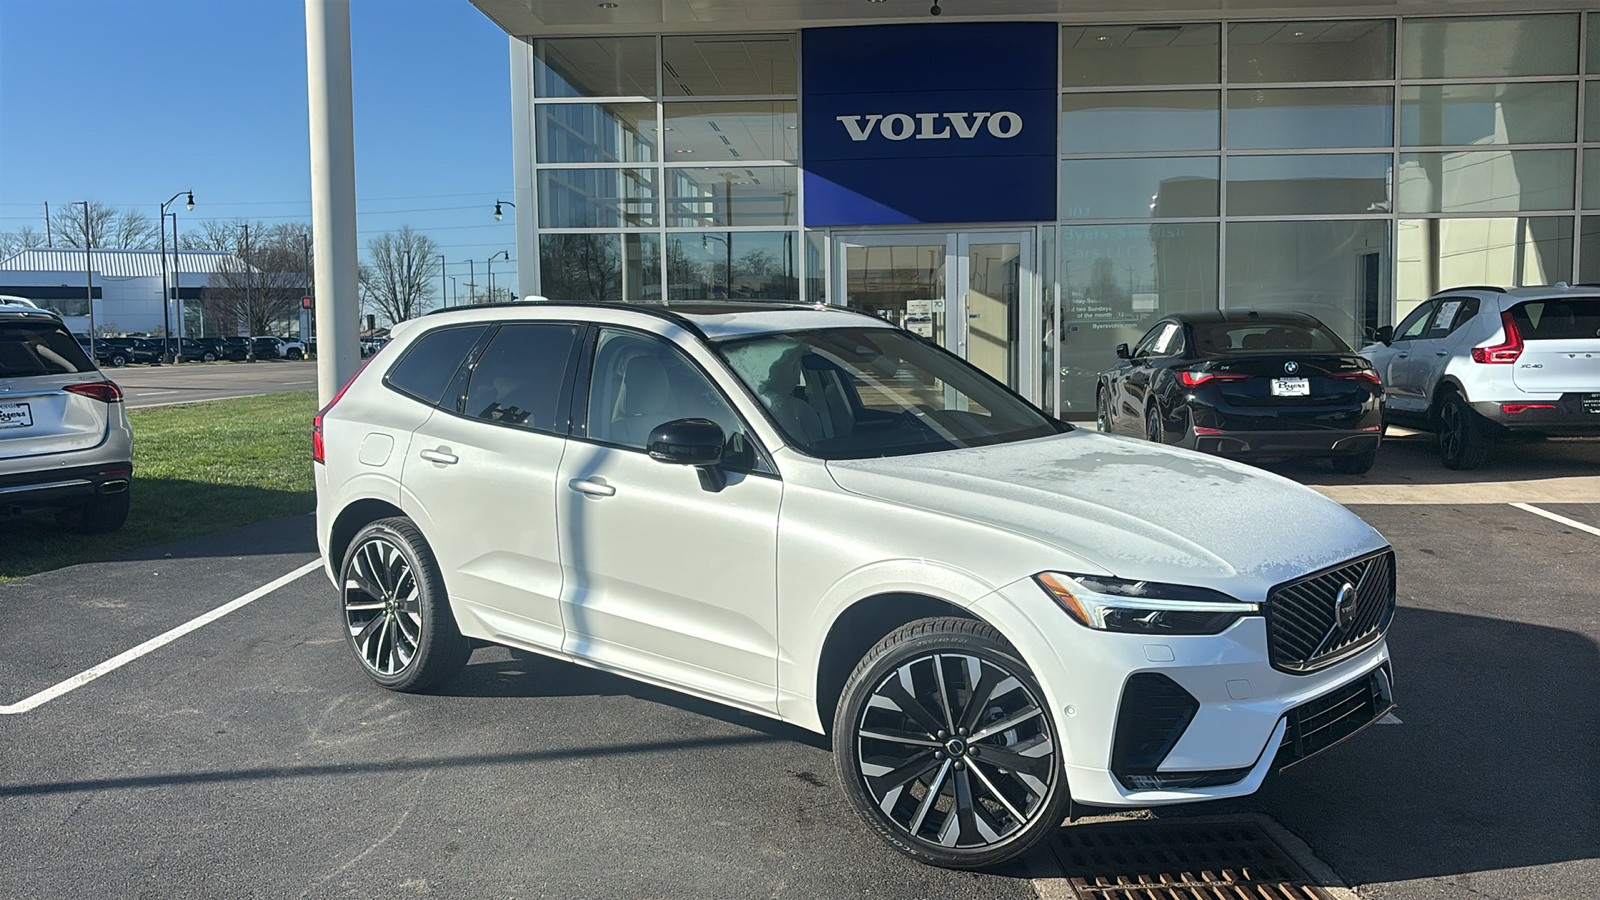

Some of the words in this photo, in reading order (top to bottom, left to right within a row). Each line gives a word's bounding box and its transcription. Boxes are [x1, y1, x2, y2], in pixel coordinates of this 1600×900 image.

[836, 111, 1023, 141] VOLVO
[1064, 228, 1109, 242] Byers
[1275, 381, 1305, 391] Byers
